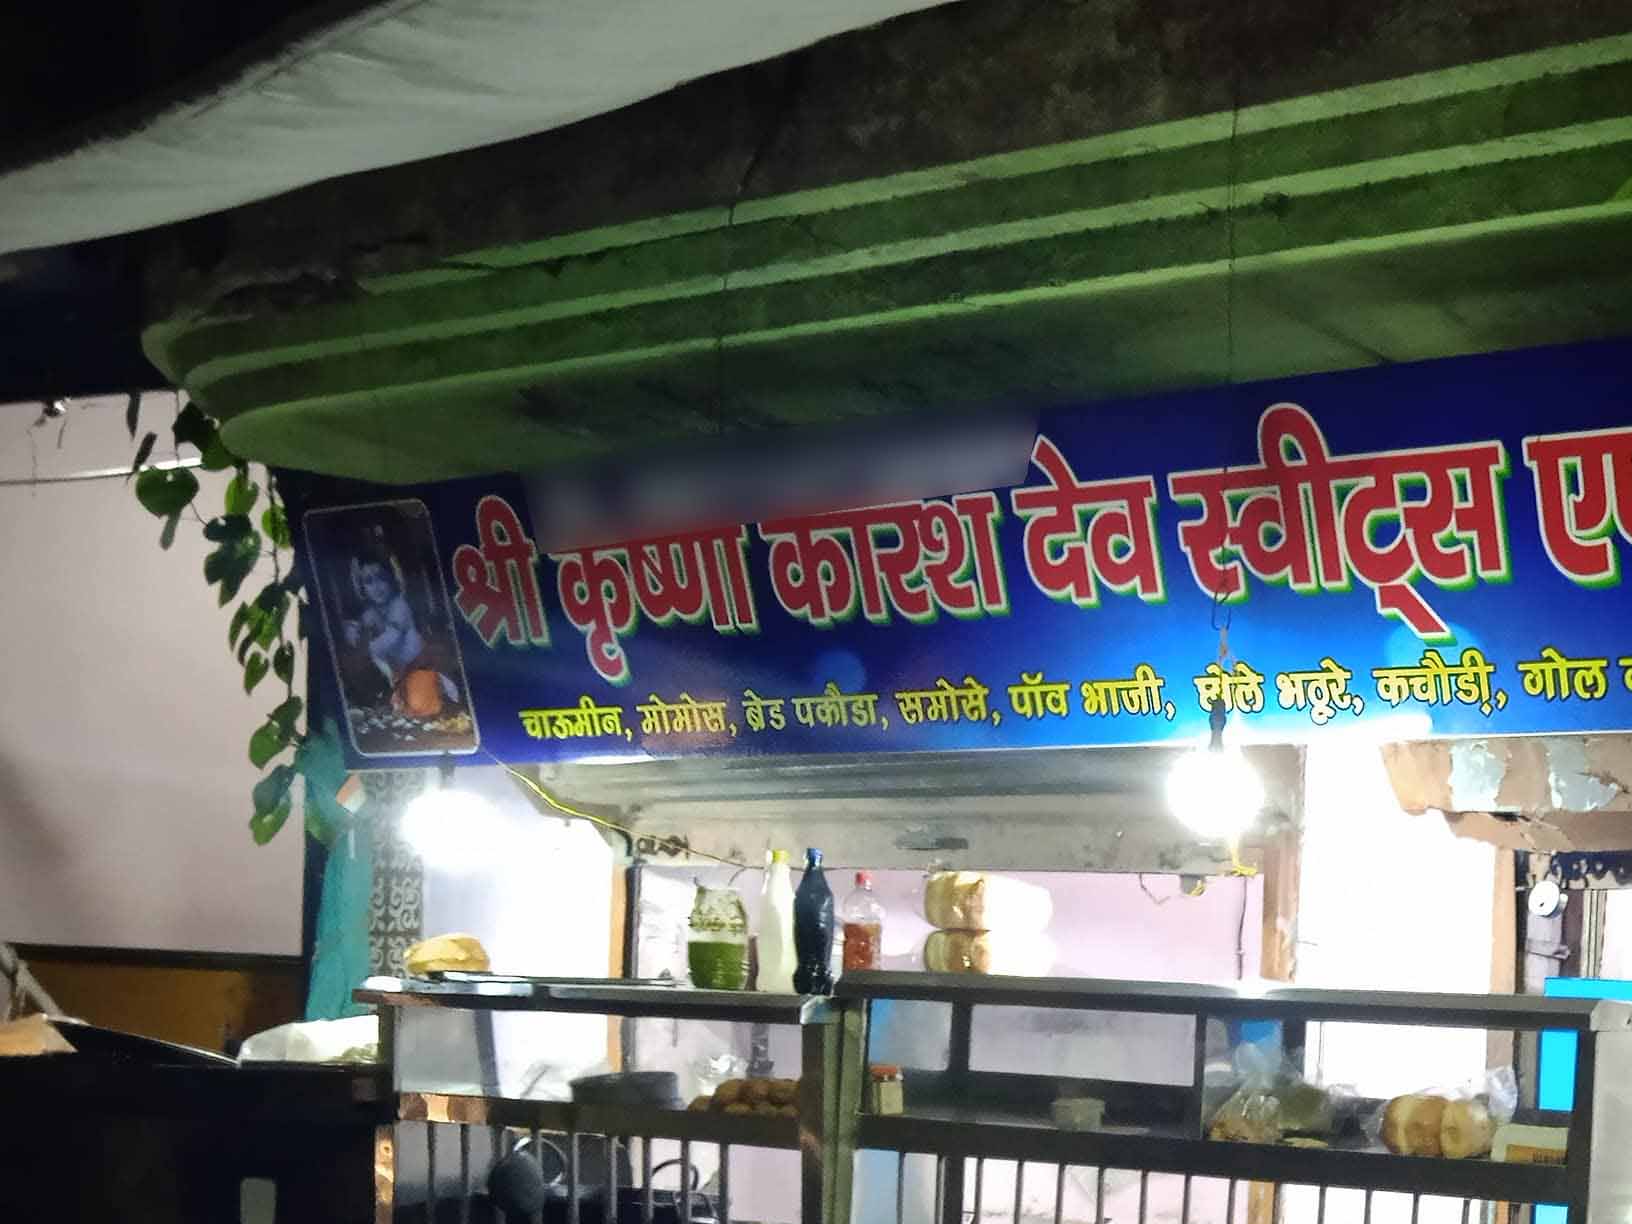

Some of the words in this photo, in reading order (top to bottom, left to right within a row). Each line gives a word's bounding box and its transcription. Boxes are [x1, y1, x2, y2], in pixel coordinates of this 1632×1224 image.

[453, 492, 550, 649] श्री
[549, 520, 760, 684] कृष्णा
[1010, 433, 1160, 606] देव
[1168, 402, 1511, 642] स्वीट्स
[636, 691, 737, 738] मोमोस,
[741, 689, 786, 732] ब्रेड
[895, 676, 1002, 726] समोसे,
[1007, 671, 1072, 720] पॉव
[1080, 663, 1177, 721] भाजी,
[1517, 646, 1608, 701] गोल
